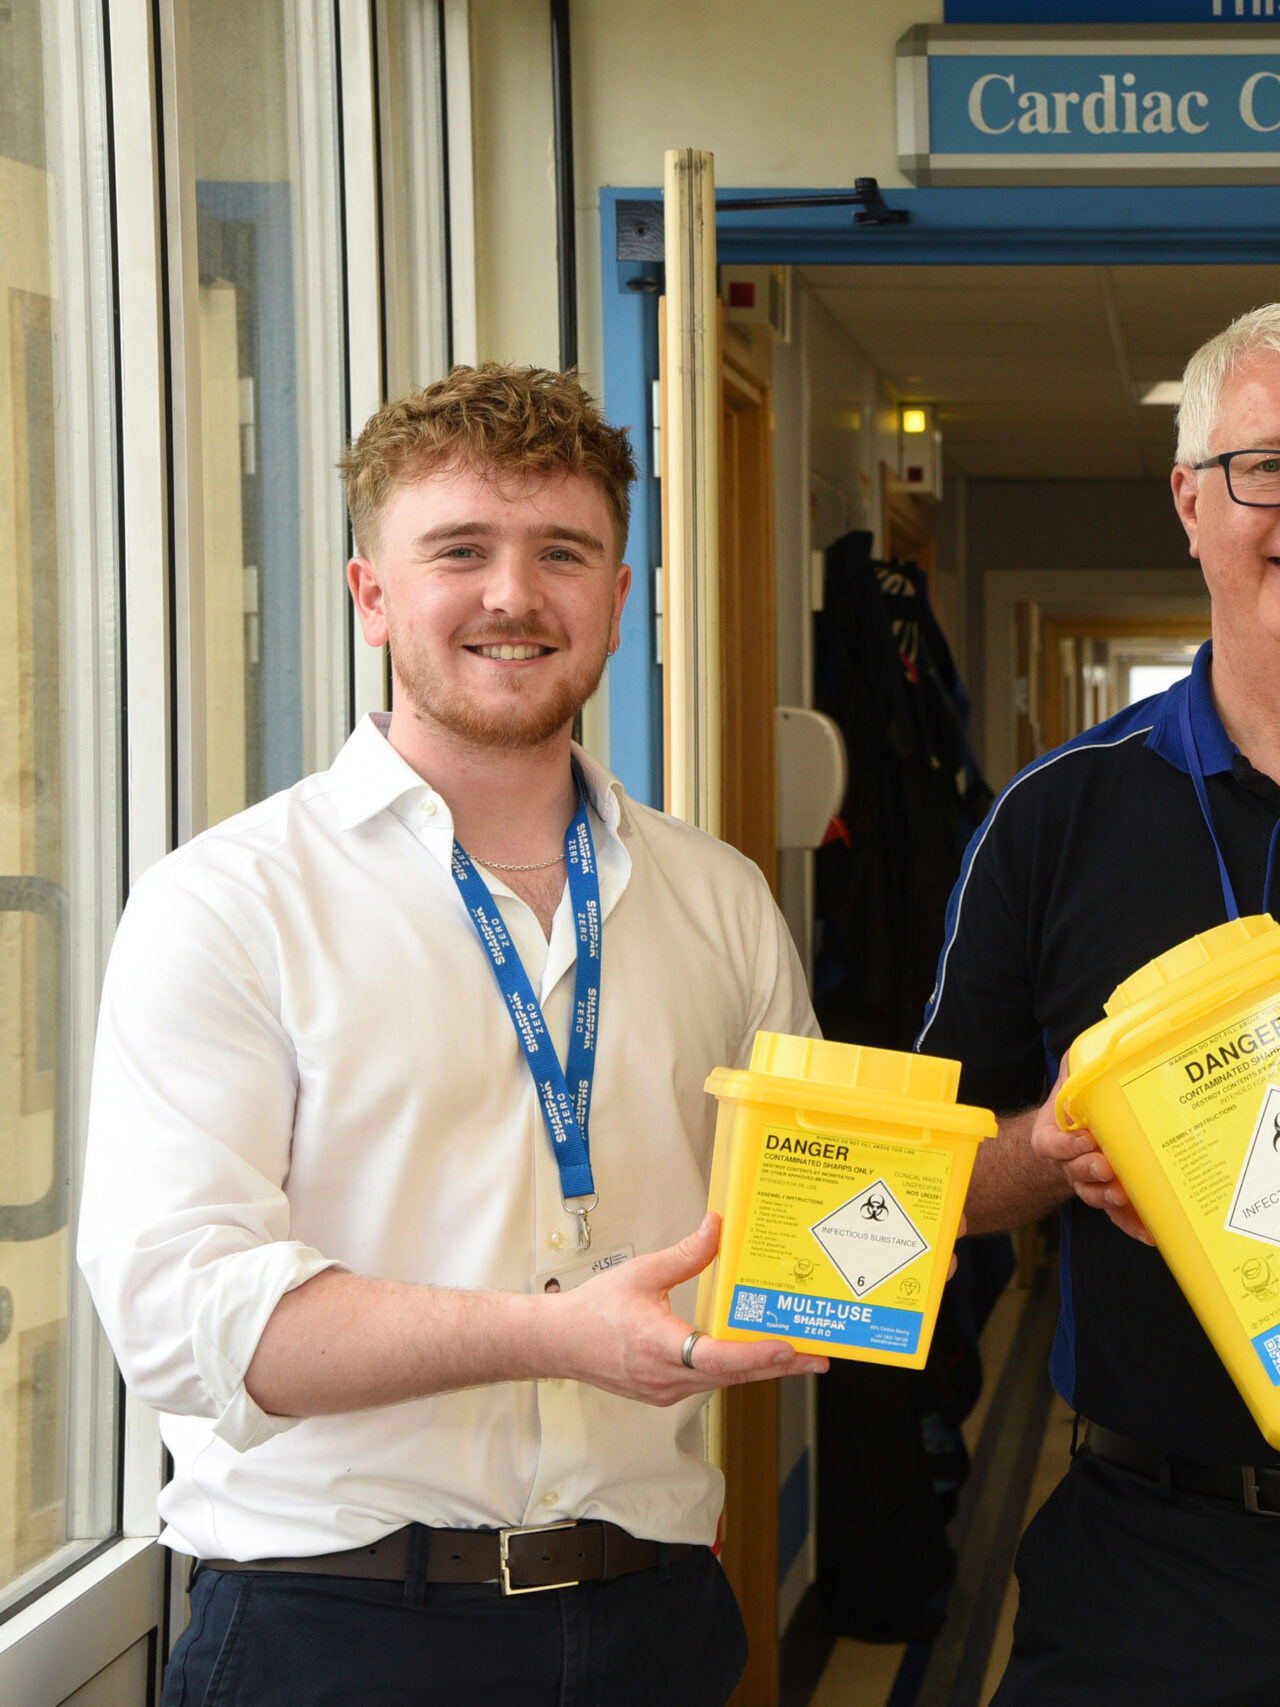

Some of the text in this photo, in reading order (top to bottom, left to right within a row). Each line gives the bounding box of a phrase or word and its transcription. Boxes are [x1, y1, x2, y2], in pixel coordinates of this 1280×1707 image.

[968, 73, 1210, 135] Cardiac
[568, 840, 578, 864] ZERO
[491, 918, 509, 947] ZERO
[577, 913, 588, 942] ZERO
[586, 900, 600, 960] SHARPAK
[507, 992, 539, 1053] SHARPAK
[527, 1003, 544, 1034] ZERO
[575, 1001, 585, 1033] ZERO
[584, 988, 597, 1051] SHARPAK
[1198, 1041, 1209, 1050] DO
[1208, 1034, 1223, 1045] NOT
[1222, 1026, 1237, 1037] FILL
[1177, 1061, 1252, 1105] CONTAMINATED
[1190, 1089, 1223, 1110] DESTROY
[1221, 1070, 1258, 1094] CONTENTS
[1257, 1065, 1268, 1075] BY
[539, 1080, 567, 1143] SHARPAK
[557, 1093, 573, 1125] ZERO
[575, 1080, 589, 1140] SHARP
[1160, 1103, 1238, 1148] ASSEMBLY INSTRUCTIONS
[764, 1151, 874, 1175] CONTAMINATED SHARPS ONLY
[765, 1133, 849, 1162] DANGER
[821, 1225, 917, 1248] INFECTIOUS SUBSTANCE
[856, 1275, 865, 1287] 6
[776, 1293, 873, 1324] MULTI-USE
[792, 1312, 846, 1331] SHARPAK
[803, 1326, 831, 1337] ZERO
